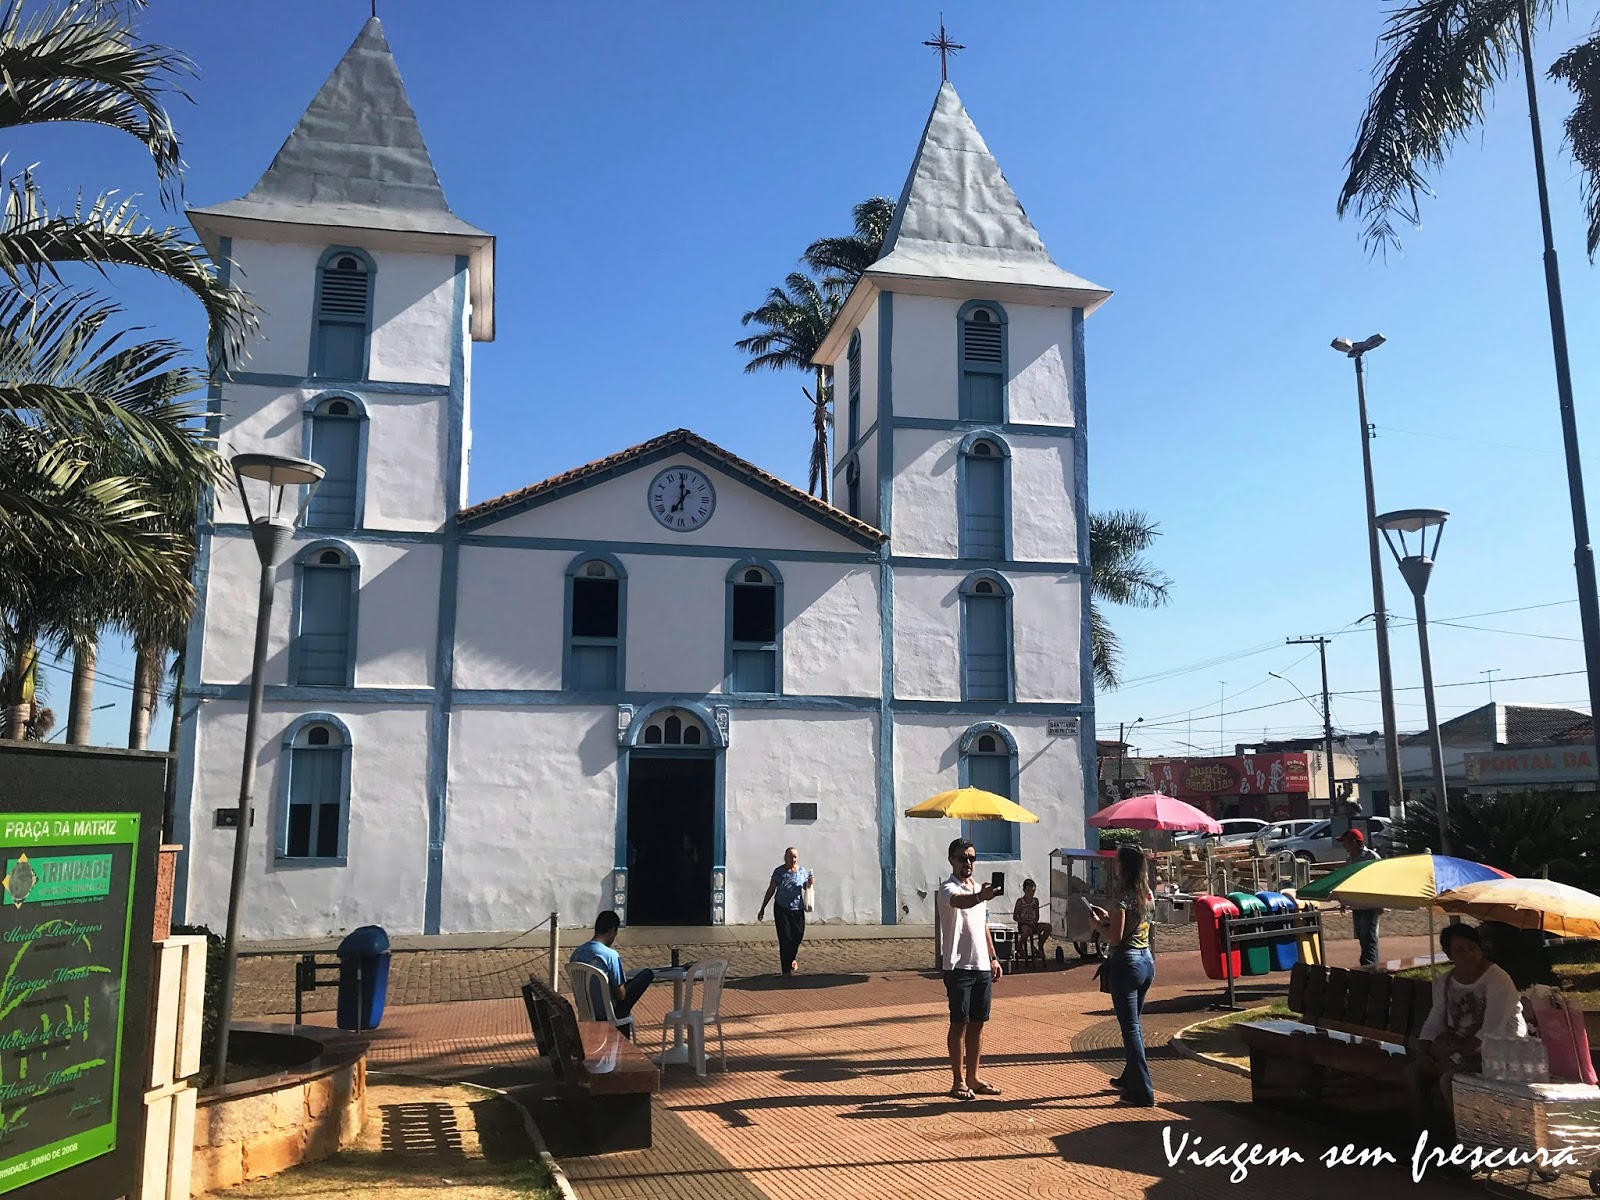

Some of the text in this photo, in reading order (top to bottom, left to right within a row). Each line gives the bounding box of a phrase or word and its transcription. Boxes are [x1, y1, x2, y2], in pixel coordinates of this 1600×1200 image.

[1190, 763, 1228, 777] Mundo
[1480, 751, 1592, 772] PORTAL DA
[5, 820, 117, 842] PRAÇA DA MATRIZ
[41, 859, 110, 884] TRINDADE
[45, 920, 103, 947] Rodrigues
[6, 975, 46, 1002] George
[52, 968, 90, 983] Morais
[0, 1142, 78, 1179] RINDADE, JUNHO DE 2008
